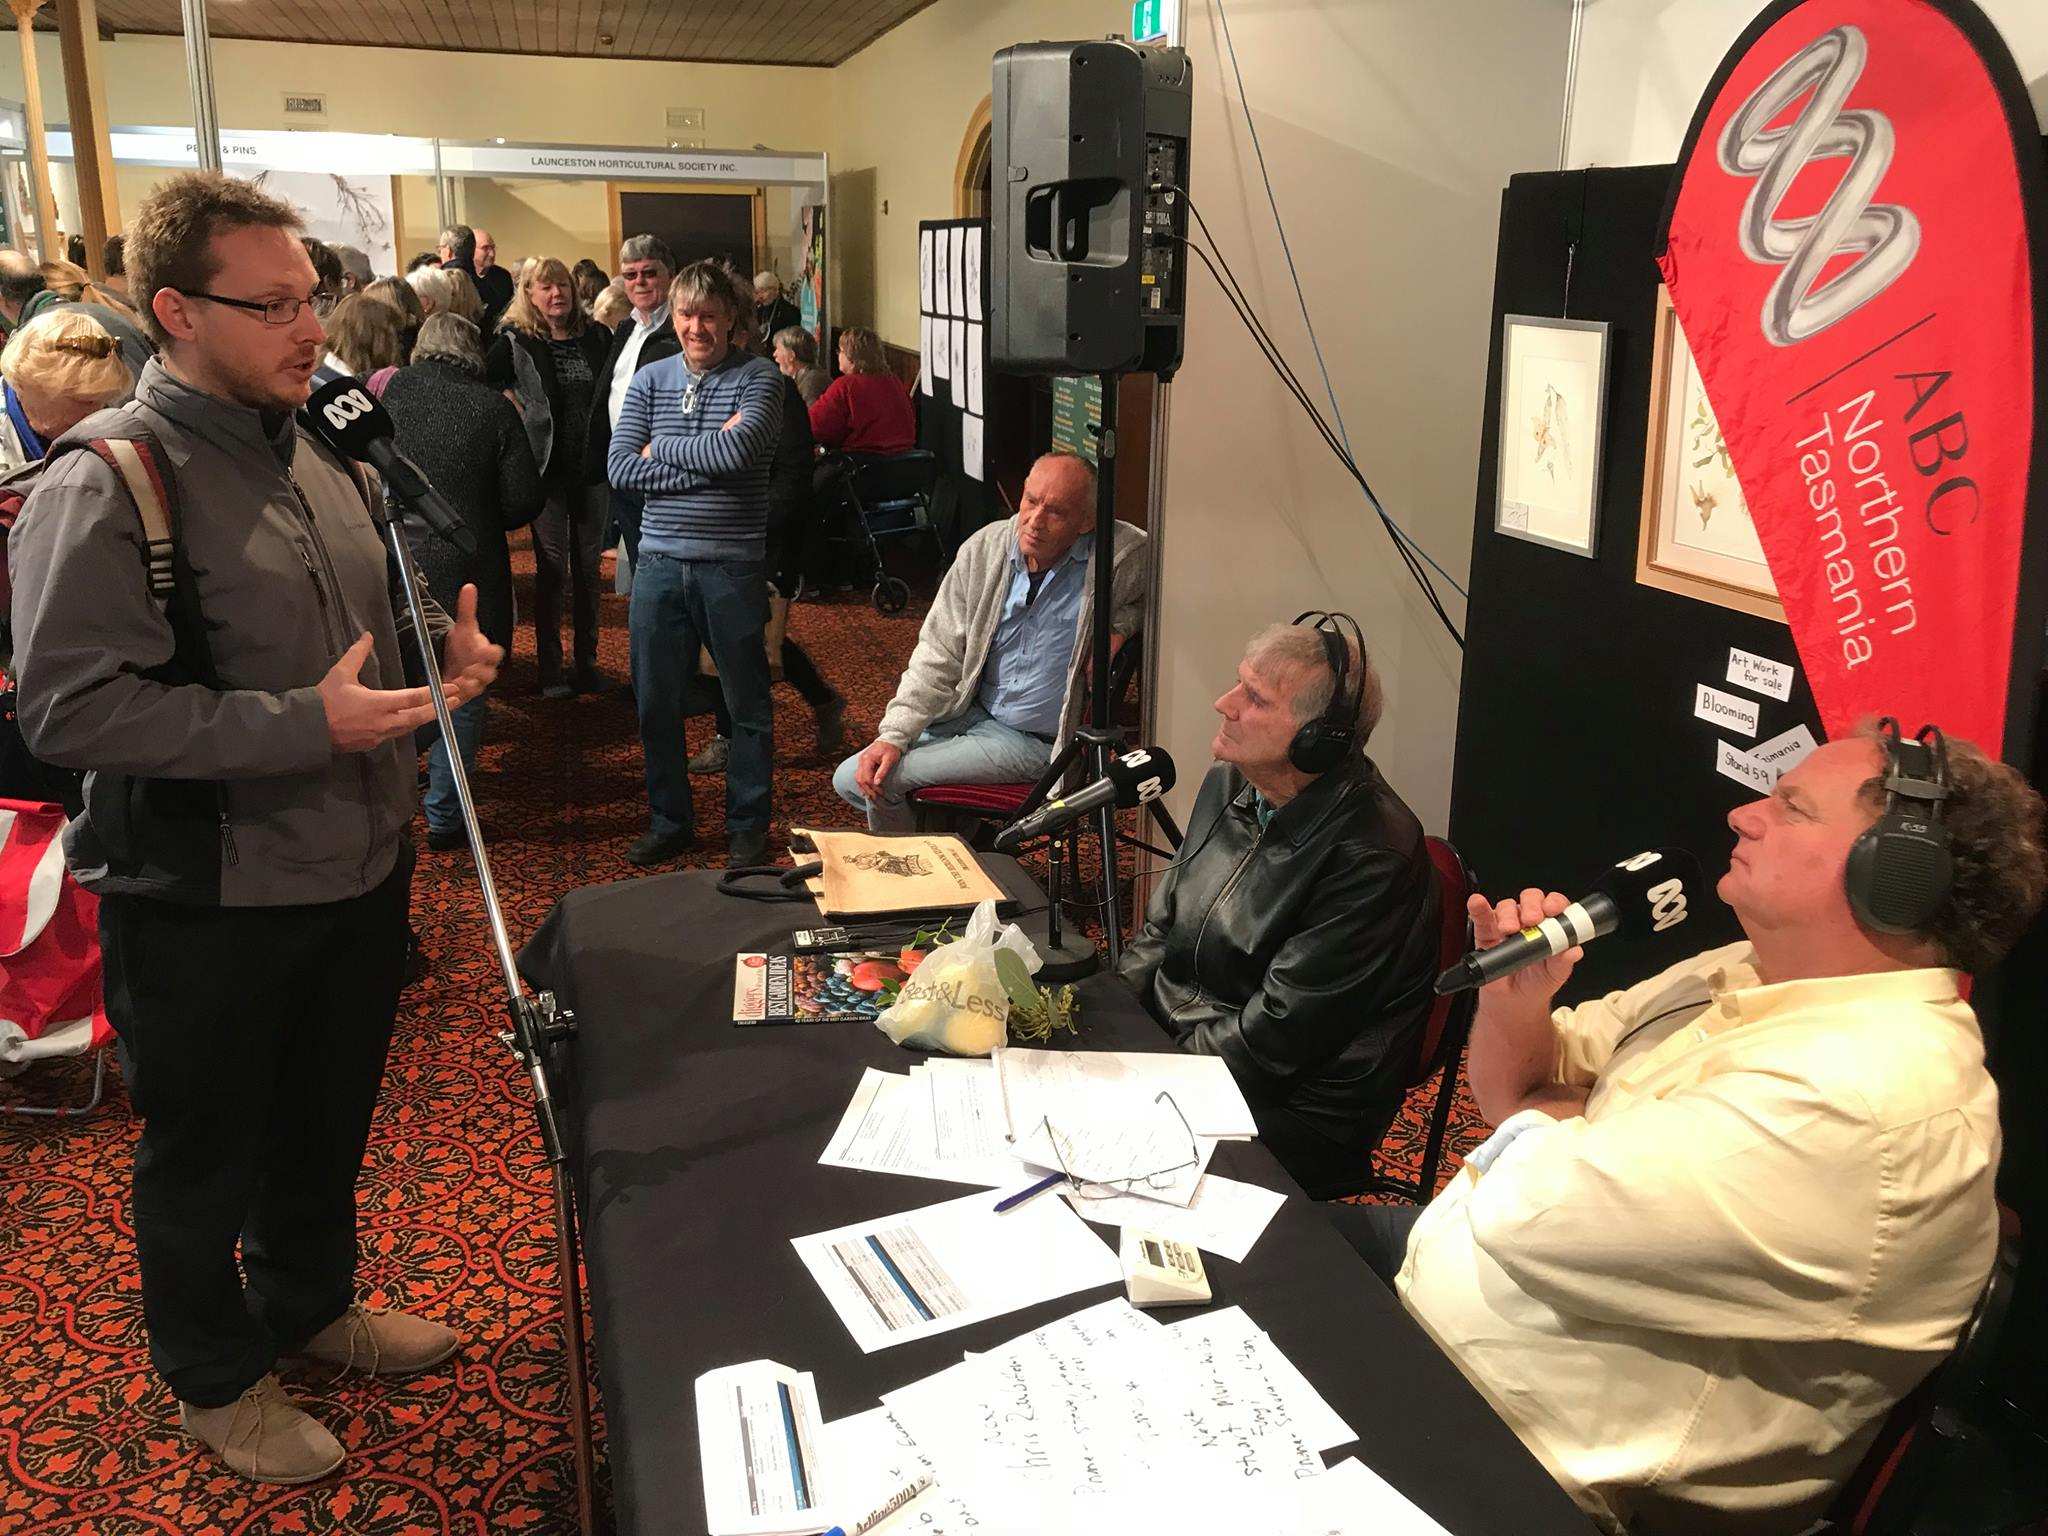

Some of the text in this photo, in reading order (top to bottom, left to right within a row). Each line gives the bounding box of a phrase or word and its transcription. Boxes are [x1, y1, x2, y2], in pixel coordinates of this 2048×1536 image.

[232, 146, 257, 155] PINS
[531, 157, 738, 172] LAUNCESTON HORTICULTURAL SOCIETY INC.
[1894, 369, 1982, 537] ABC
[1838, 389, 1919, 636] Northern
[1795, 411, 1874, 670] Tasmania
[1731, 653, 1779, 676] Art Work
[1744, 669, 1783, 691] for sale
[1702, 691, 1755, 730] Blooming
[1724, 751, 1770, 785] Stand 59
[767, 955, 787, 1016] BEST GARDEN IDEAS
